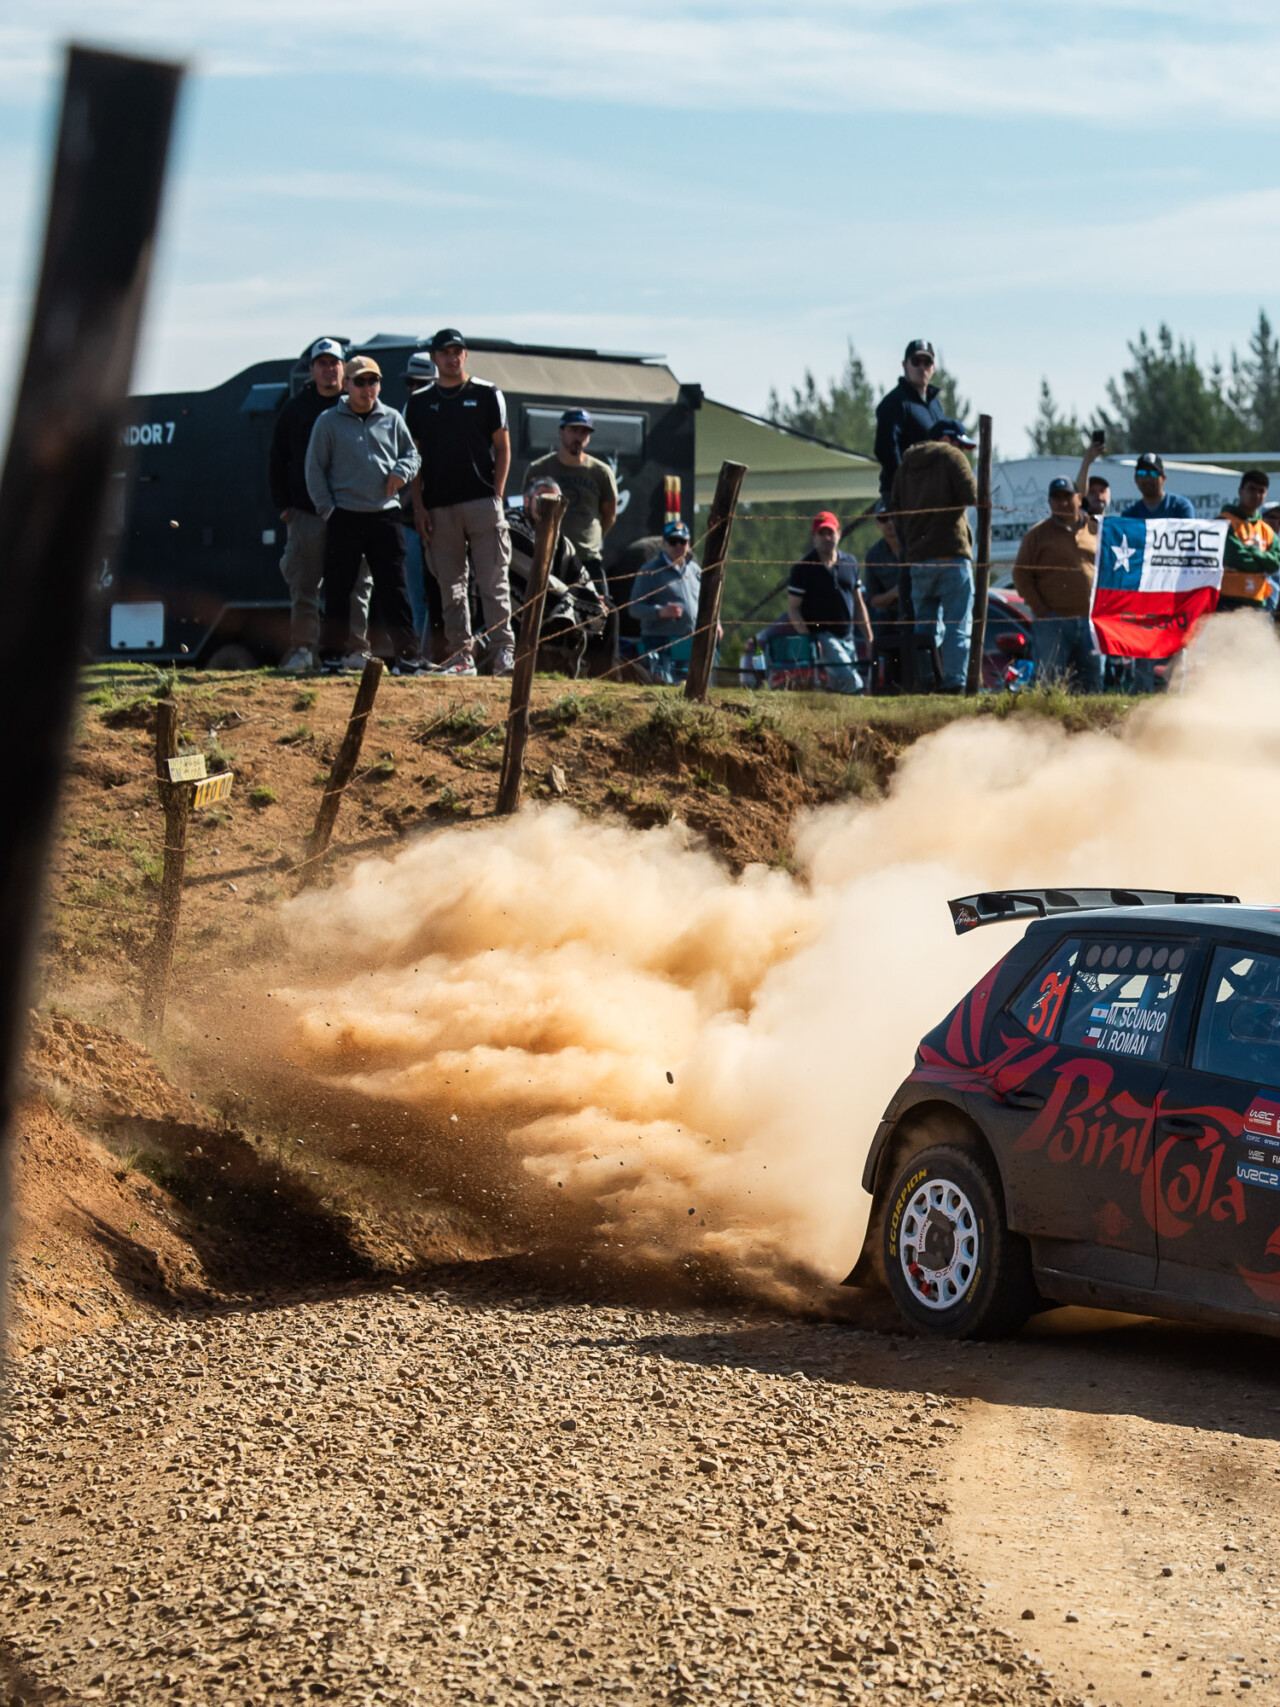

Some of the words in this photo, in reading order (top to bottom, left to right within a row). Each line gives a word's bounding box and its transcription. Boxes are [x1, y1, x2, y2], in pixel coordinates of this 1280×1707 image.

[122, 423, 162, 446] NDOR
[165, 421, 176, 444] 7
[1153, 530, 1219, 552] WRC
[1026, 972, 1071, 1037] 31
[1105, 1006, 1117, 1025] M.
[1120, 1007, 1167, 1032] SCUNCIO
[1097, 1029, 1106, 1049] J.
[1107, 1031, 1149, 1056] ROMAN
[1249, 1109, 1275, 1121] WRC
[1013, 1058, 1174, 1175] Point
[1141, 1122, 1247, 1238] Cola
[1236, 1166, 1278, 1186] WRC2
[889, 1168, 928, 1257] SCORPION
